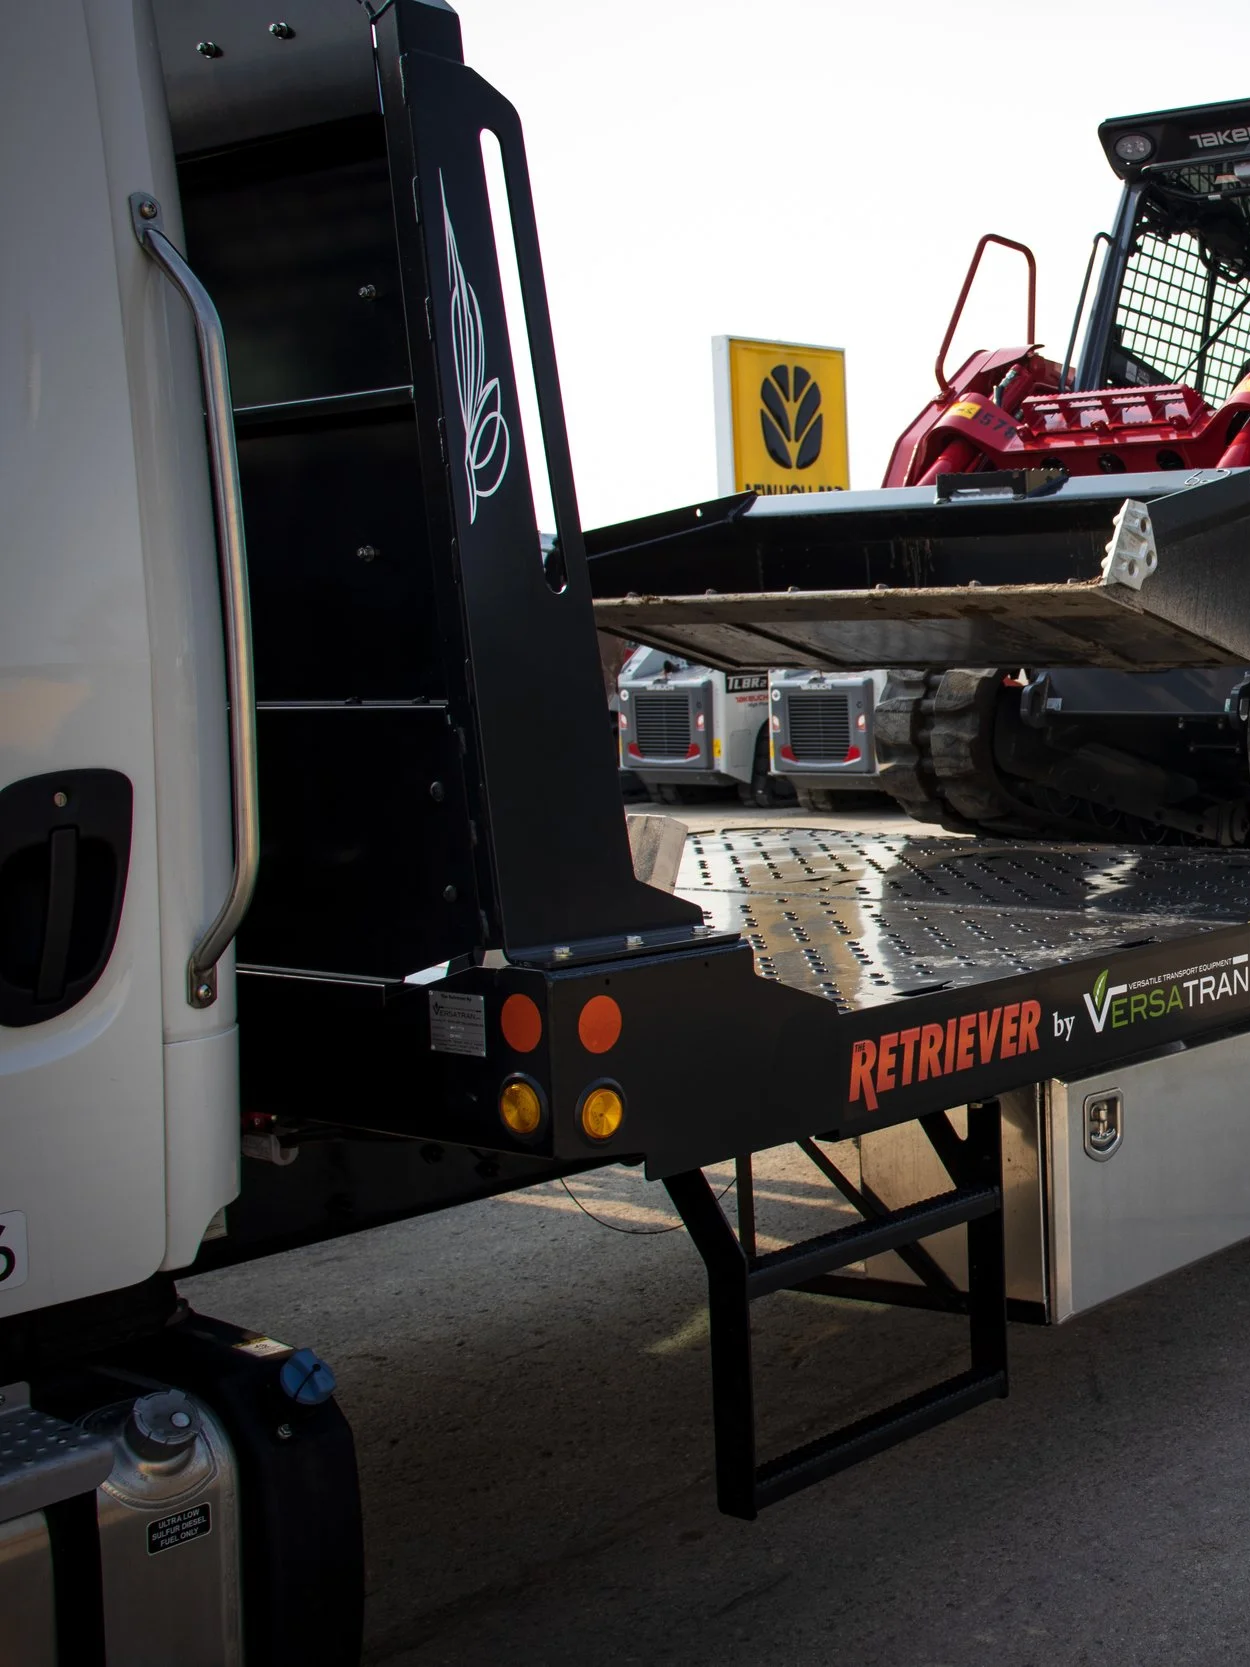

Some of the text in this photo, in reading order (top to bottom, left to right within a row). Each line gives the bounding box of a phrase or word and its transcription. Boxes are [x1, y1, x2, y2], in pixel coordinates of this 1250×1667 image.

[735, 695, 769, 703] TAKEUCH
[1128, 957, 1233, 990] VERSATILE TRANSPORT EQUIPMENT
[1083, 965, 1249, 1034] VERSATRAN
[849, 1000, 1076, 1111] RETRIEVER by
[855, 1041, 866, 1053] THE
[152, 1516, 206, 1541] SULFUR DIESEL
[158, 1508, 200, 1529] ULTRA LOW
[160, 1527, 199, 1547] FUEL ONLY
